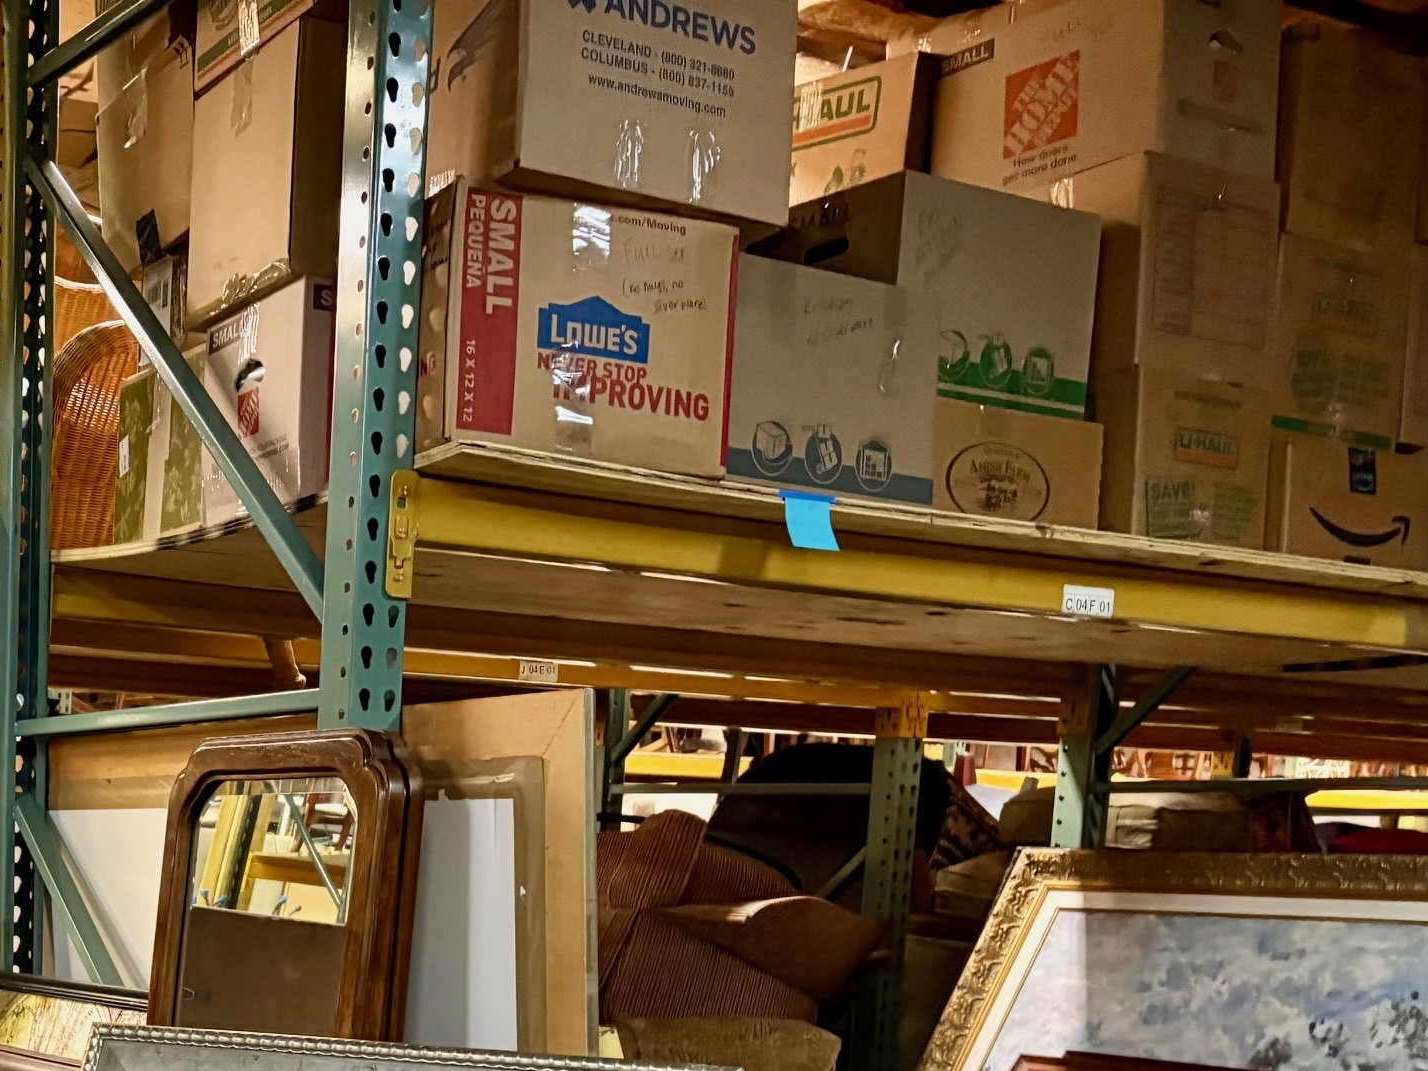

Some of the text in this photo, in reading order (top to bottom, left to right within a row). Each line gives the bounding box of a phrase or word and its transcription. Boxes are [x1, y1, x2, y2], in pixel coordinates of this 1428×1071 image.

[604, 0, 756, 54] ANDREWS
[581, 47, 648, 75] COLUMBUS
[659, 66, 685, 86] (800)
[582, 29, 651, 58] CLEVELAND
[661, 50, 687, 71] (800)
[588, 74, 726, 118] www.andrewsmoving.com
[466, 194, 486, 288] PEQUEÑA
[486, 198, 517, 314] SMALL
[213, 316, 248, 349] SMAL
[466, 339, 476, 354] 16
[550, 314, 639, 355] LOWE'S
[464, 373, 475, 388] 12
[537, 352, 647, 384] NER STOP
[463, 407, 473, 422] 12
[1065, 598, 1110, 613] C 04 F 01
